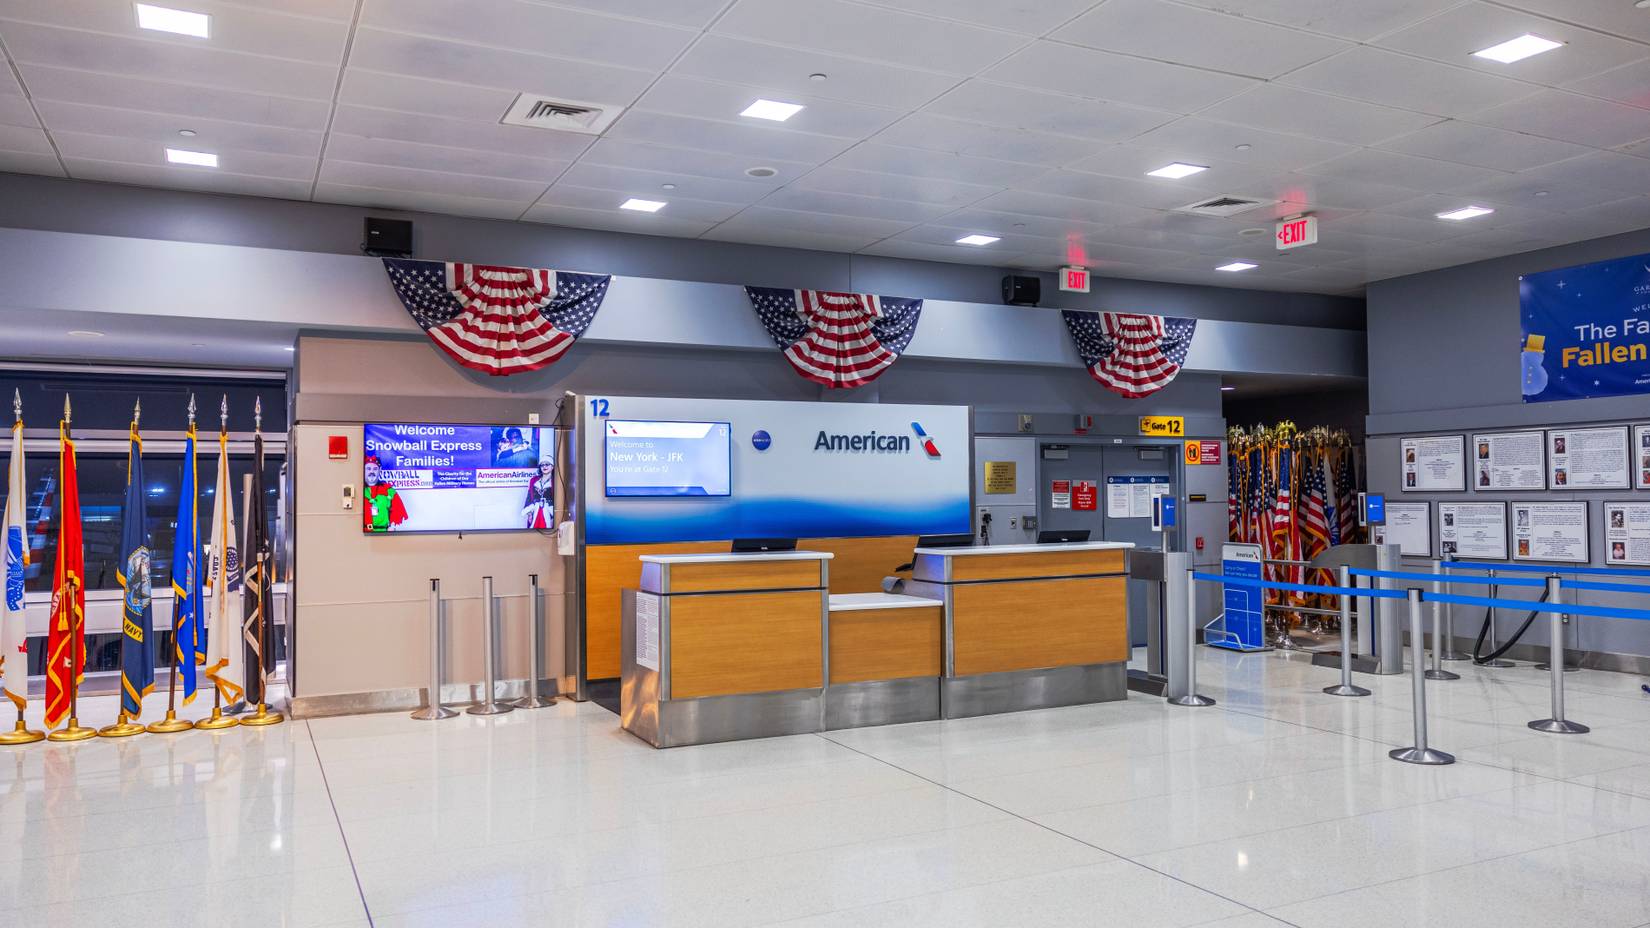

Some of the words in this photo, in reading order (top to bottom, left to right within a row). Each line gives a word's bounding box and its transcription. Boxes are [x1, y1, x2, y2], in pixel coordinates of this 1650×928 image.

[1283, 220, 1307, 245] EXIT
[1067, 271, 1086, 289] EXIT
[1573, 322, 1617, 341] The
[1562, 341, 1647, 368] Fallen
[590, 398, 610, 417] 12
[394, 425, 455, 435] Welcome
[1151, 422, 1167, 431] Gate
[1167, 420, 1181, 433] 12
[366, 440, 427, 451] Snowball
[431, 440, 482, 453] Express
[814, 430, 910, 451] American
[396, 455, 454, 466] Families!
[610, 451, 634, 462] New
[636, 451, 658, 462] York
[667, 452, 684, 462] JFK
[124, 623, 142, 638] NAVY
